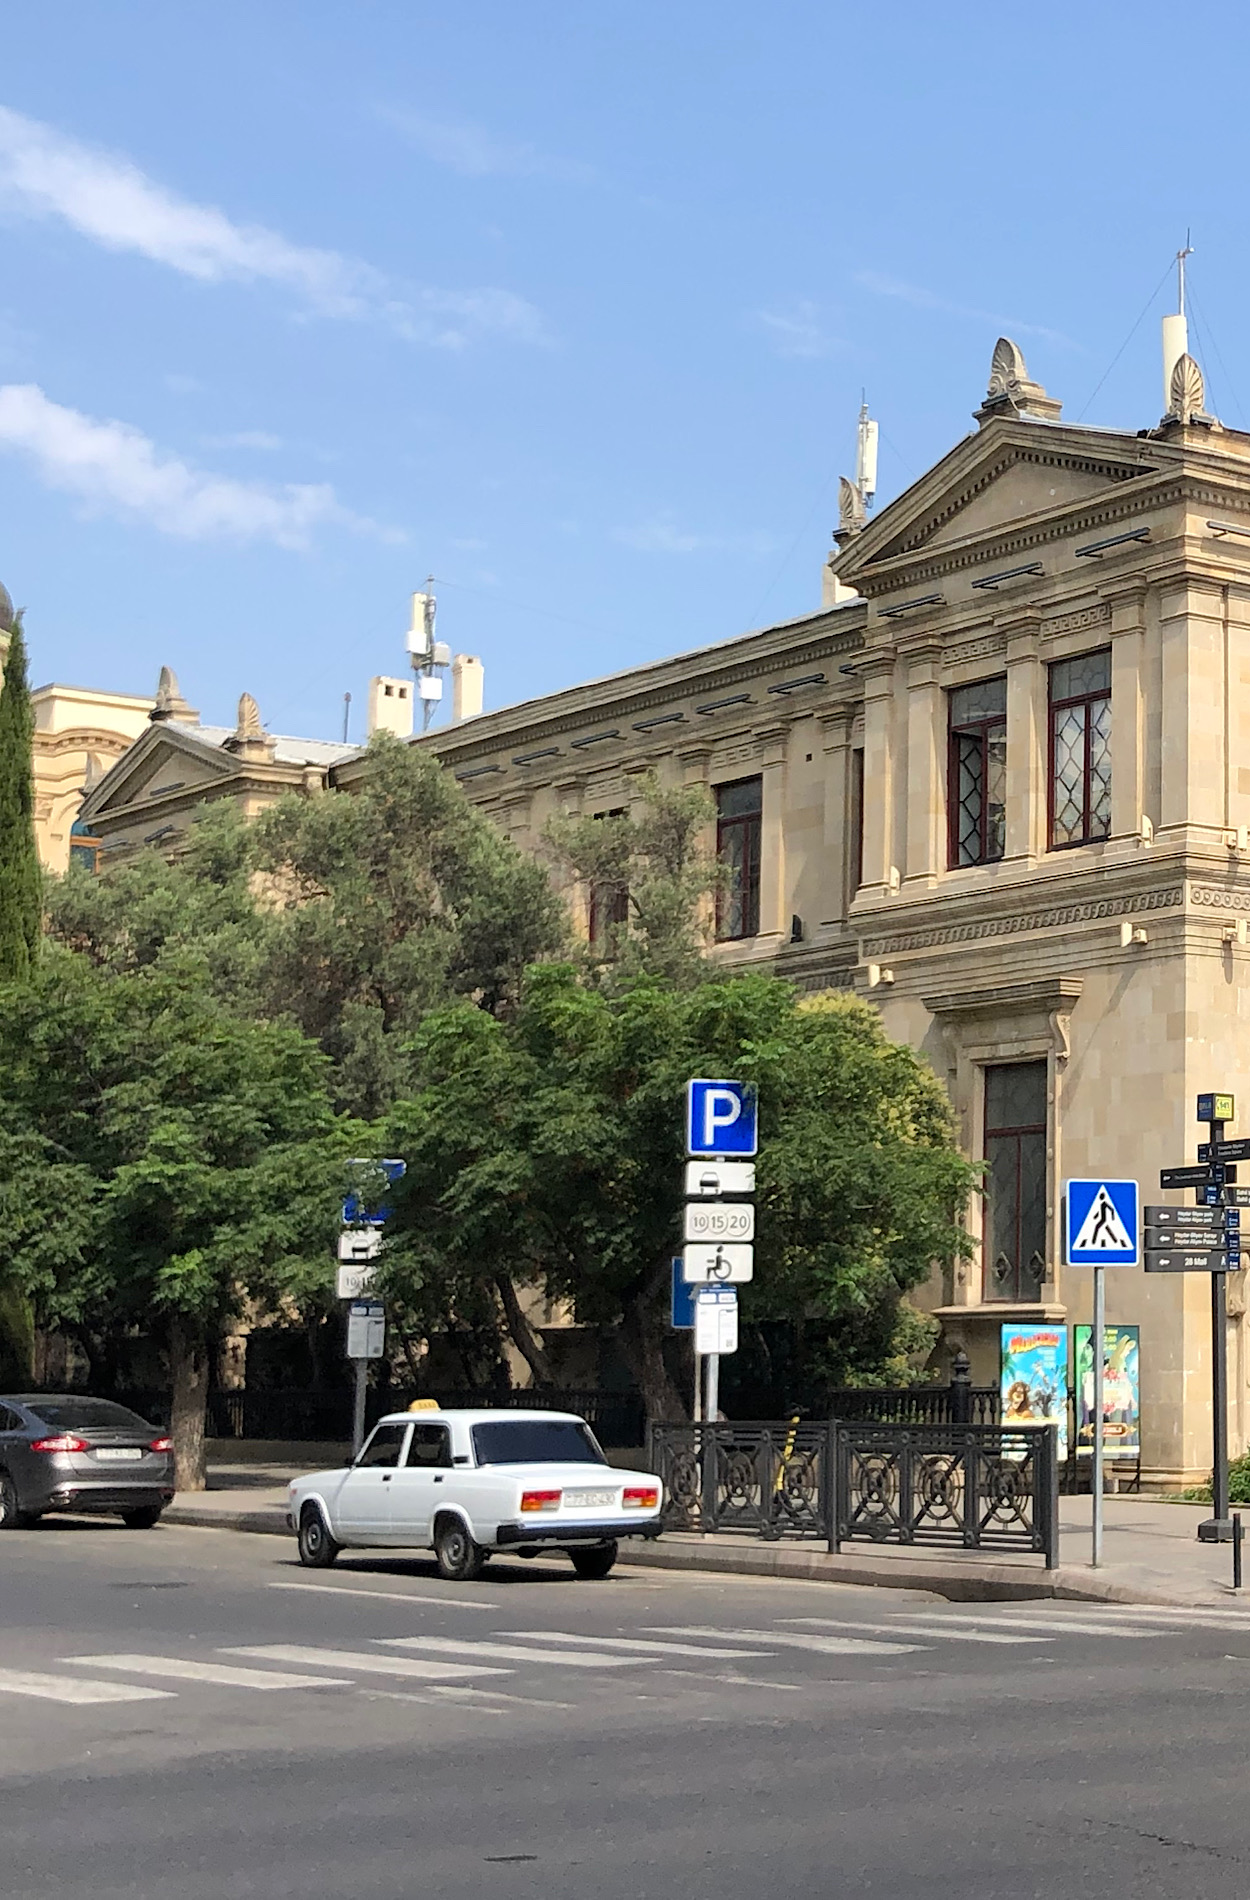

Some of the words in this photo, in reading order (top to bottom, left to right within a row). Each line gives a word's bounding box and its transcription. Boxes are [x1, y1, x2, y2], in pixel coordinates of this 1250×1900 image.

[704, 1088, 741, 1146] P
[694, 1216, 706, 1227] 10
[711, 1215, 724, 1228] 15
[730, 1215, 748, 1228] 20
